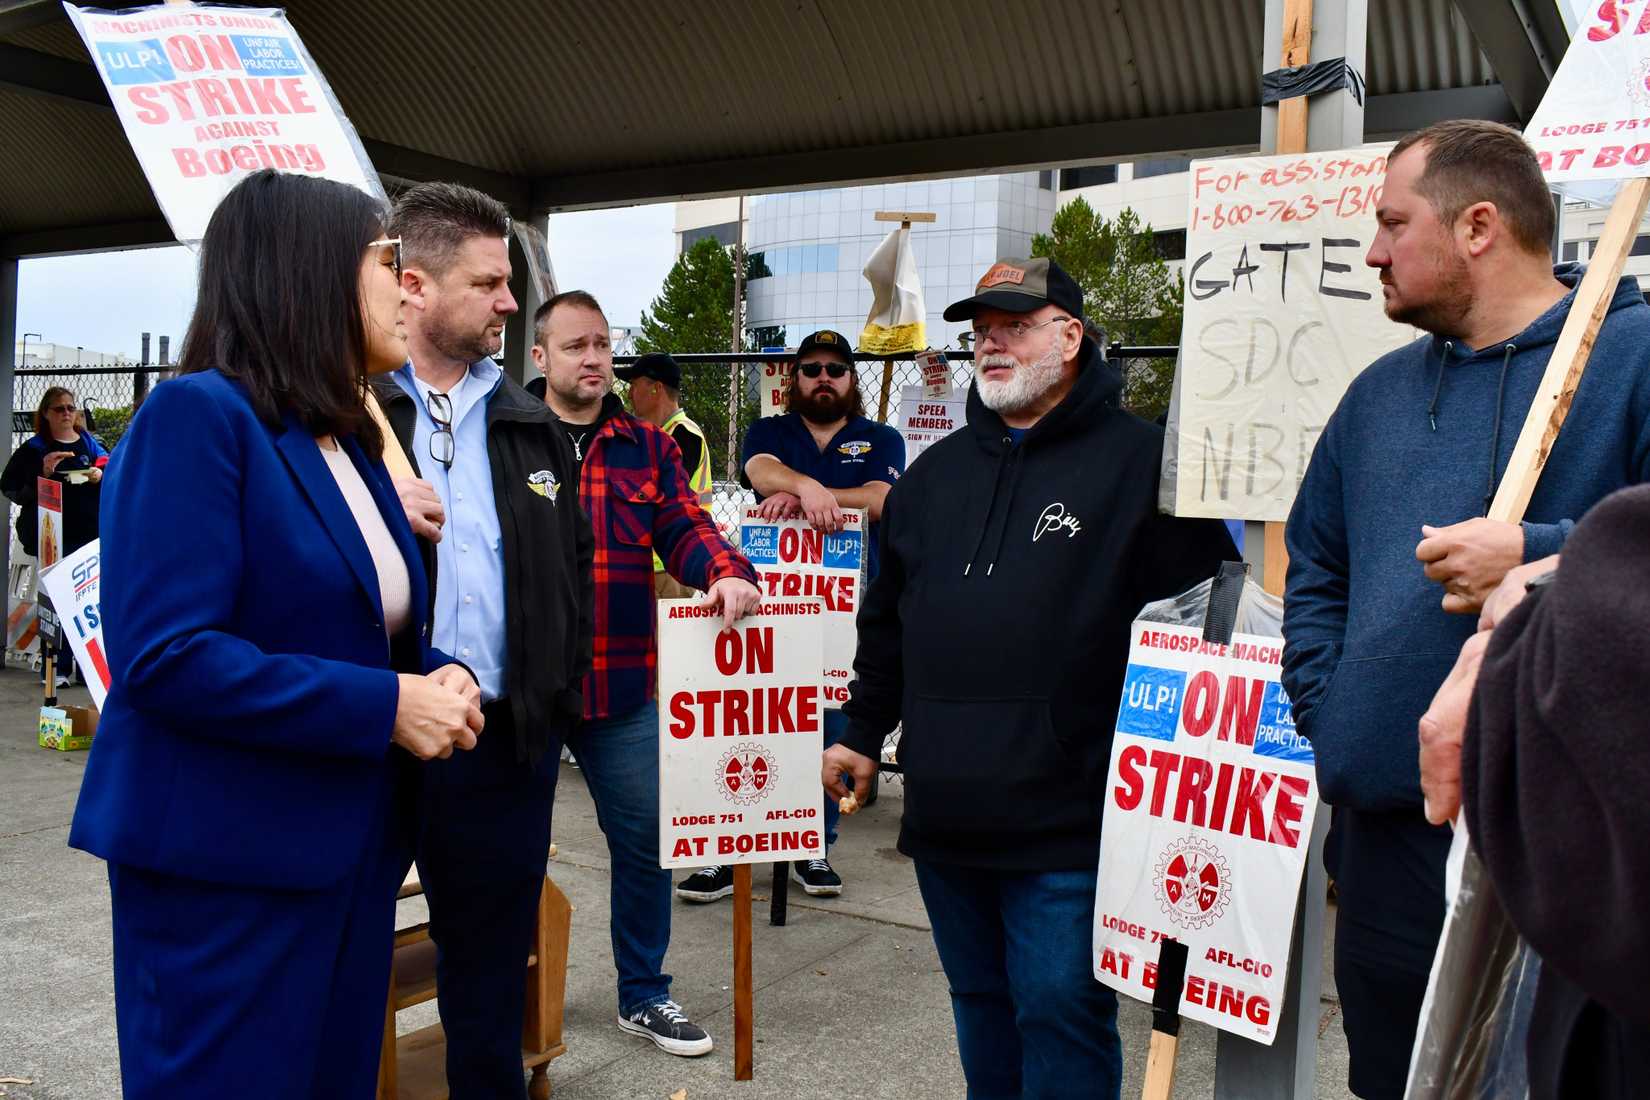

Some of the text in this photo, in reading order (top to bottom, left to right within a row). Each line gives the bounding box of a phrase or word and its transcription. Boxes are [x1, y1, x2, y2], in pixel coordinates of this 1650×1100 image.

[94, 14, 279, 34] MACHINISTS UNION
[106, 34, 243, 73] ULP! ON
[242, 37, 282, 48] UNFAIR
[249, 48, 285, 59] LABOR
[127, 78, 317, 125] STRIKE
[194, 121, 281, 142] AGAINST
[1540, 121, 1608, 138] LODGE
[171, 140, 326, 178] Boeing
[1195, 166, 1249, 199] For
[1188, 236, 1373, 304] GATE
[1196, 316, 1326, 402] SDC
[908, 417, 954, 430] MEMBERS
[918, 404, 946, 417] SPEEA
[748, 528, 772, 537] UNFAIR
[750, 538, 771, 547] LABOR
[778, 527, 858, 565] ON ULP!
[756, 603, 821, 616] ACHINISTS
[714, 626, 774, 676] ON
[669, 686, 819, 739] STRIKE
[1128, 670, 1266, 746] ULP! ON
[1113, 743, 1310, 849] STRIKE
[672, 808, 817, 826] LODGE 751 AFL-CIO
[672, 829, 820, 858] AT BOEING
[1102, 914, 1146, 940] LODGE
[1204, 947, 1273, 978] AFL-CIO
[1100, 947, 1271, 1026] AT BEING
